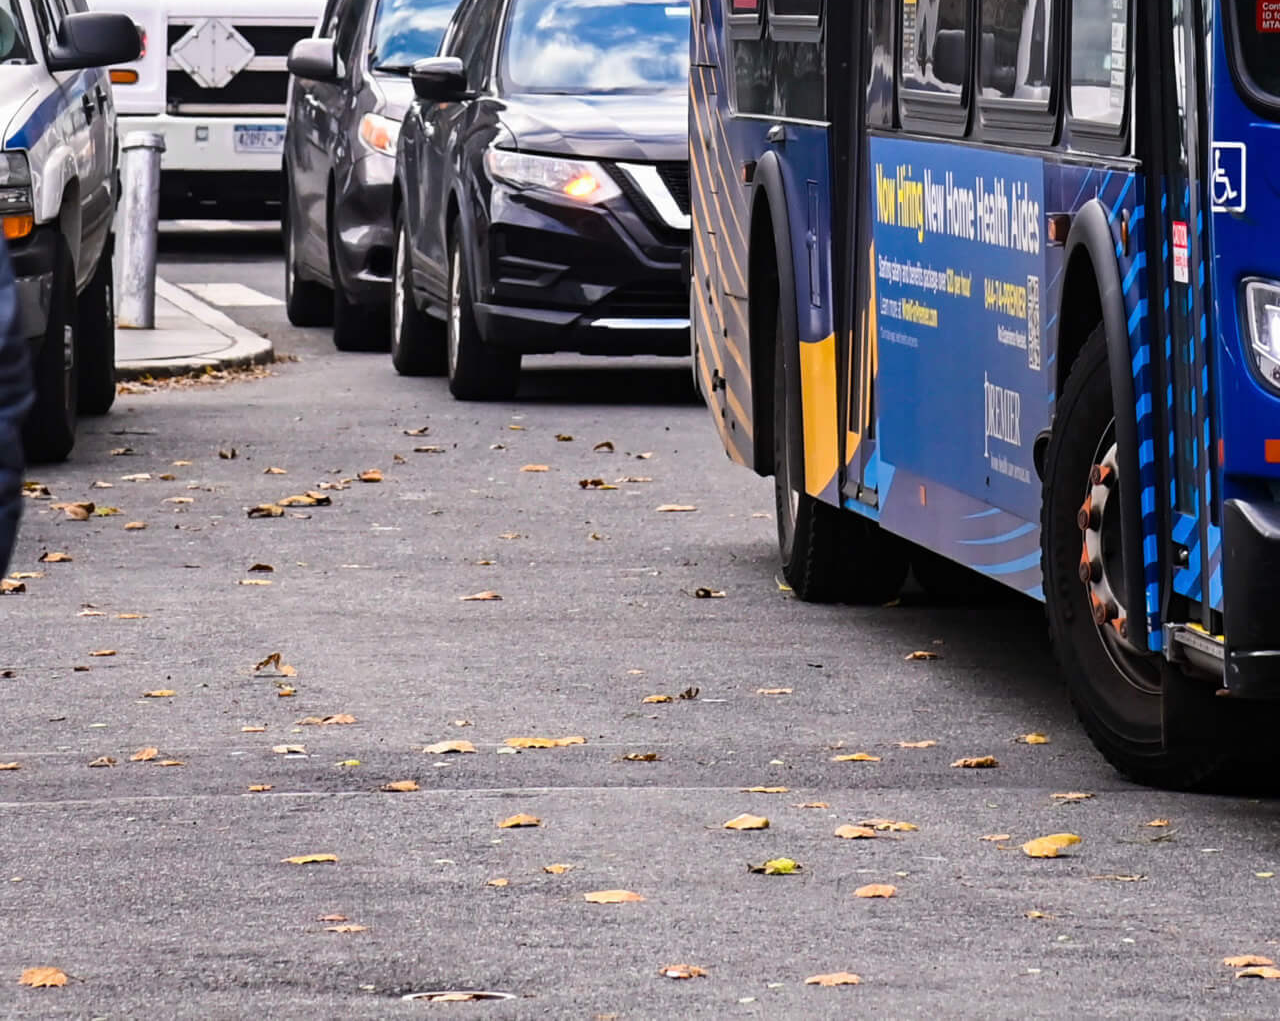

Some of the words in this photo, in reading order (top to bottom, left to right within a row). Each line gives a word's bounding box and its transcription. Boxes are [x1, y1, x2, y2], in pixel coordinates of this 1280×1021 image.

[1262, 11, 1272, 19] ID
[1262, 21, 1280, 29] MTA
[876, 163, 896, 226] Now
[896, 164, 924, 243] Hiring
[924, 168, 945, 234] New
[946, 171, 975, 241] Home
[976, 176, 1009, 248] Health
[1011, 181, 1040, 255] Aides
[984, 370, 1021, 458] PREMIER
